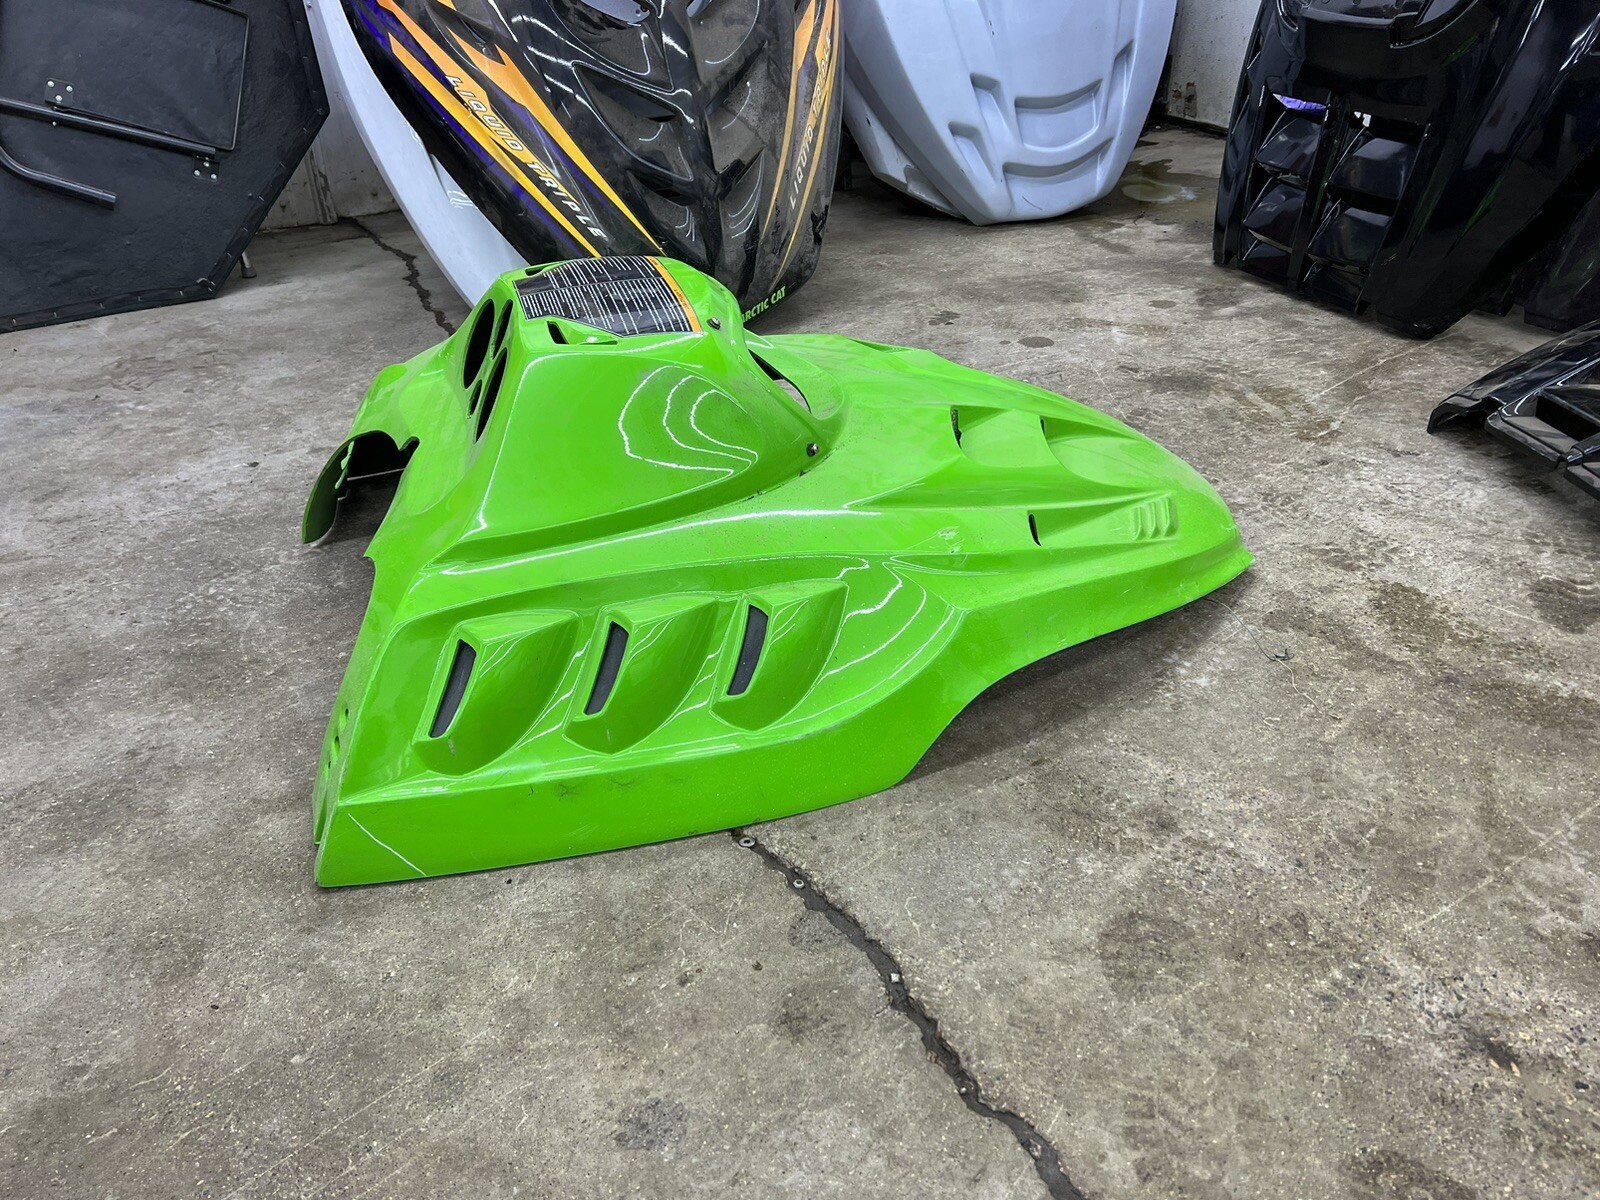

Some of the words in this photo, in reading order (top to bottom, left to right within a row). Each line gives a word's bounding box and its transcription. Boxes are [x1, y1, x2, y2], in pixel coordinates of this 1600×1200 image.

[446, 75, 525, 152] LIQUID
[527, 161, 609, 242] TRIPLE
[790, 123, 814, 210] LIQUID
[811, 29, 832, 118] TRIPLE
[771, 286, 786, 304] CAT
